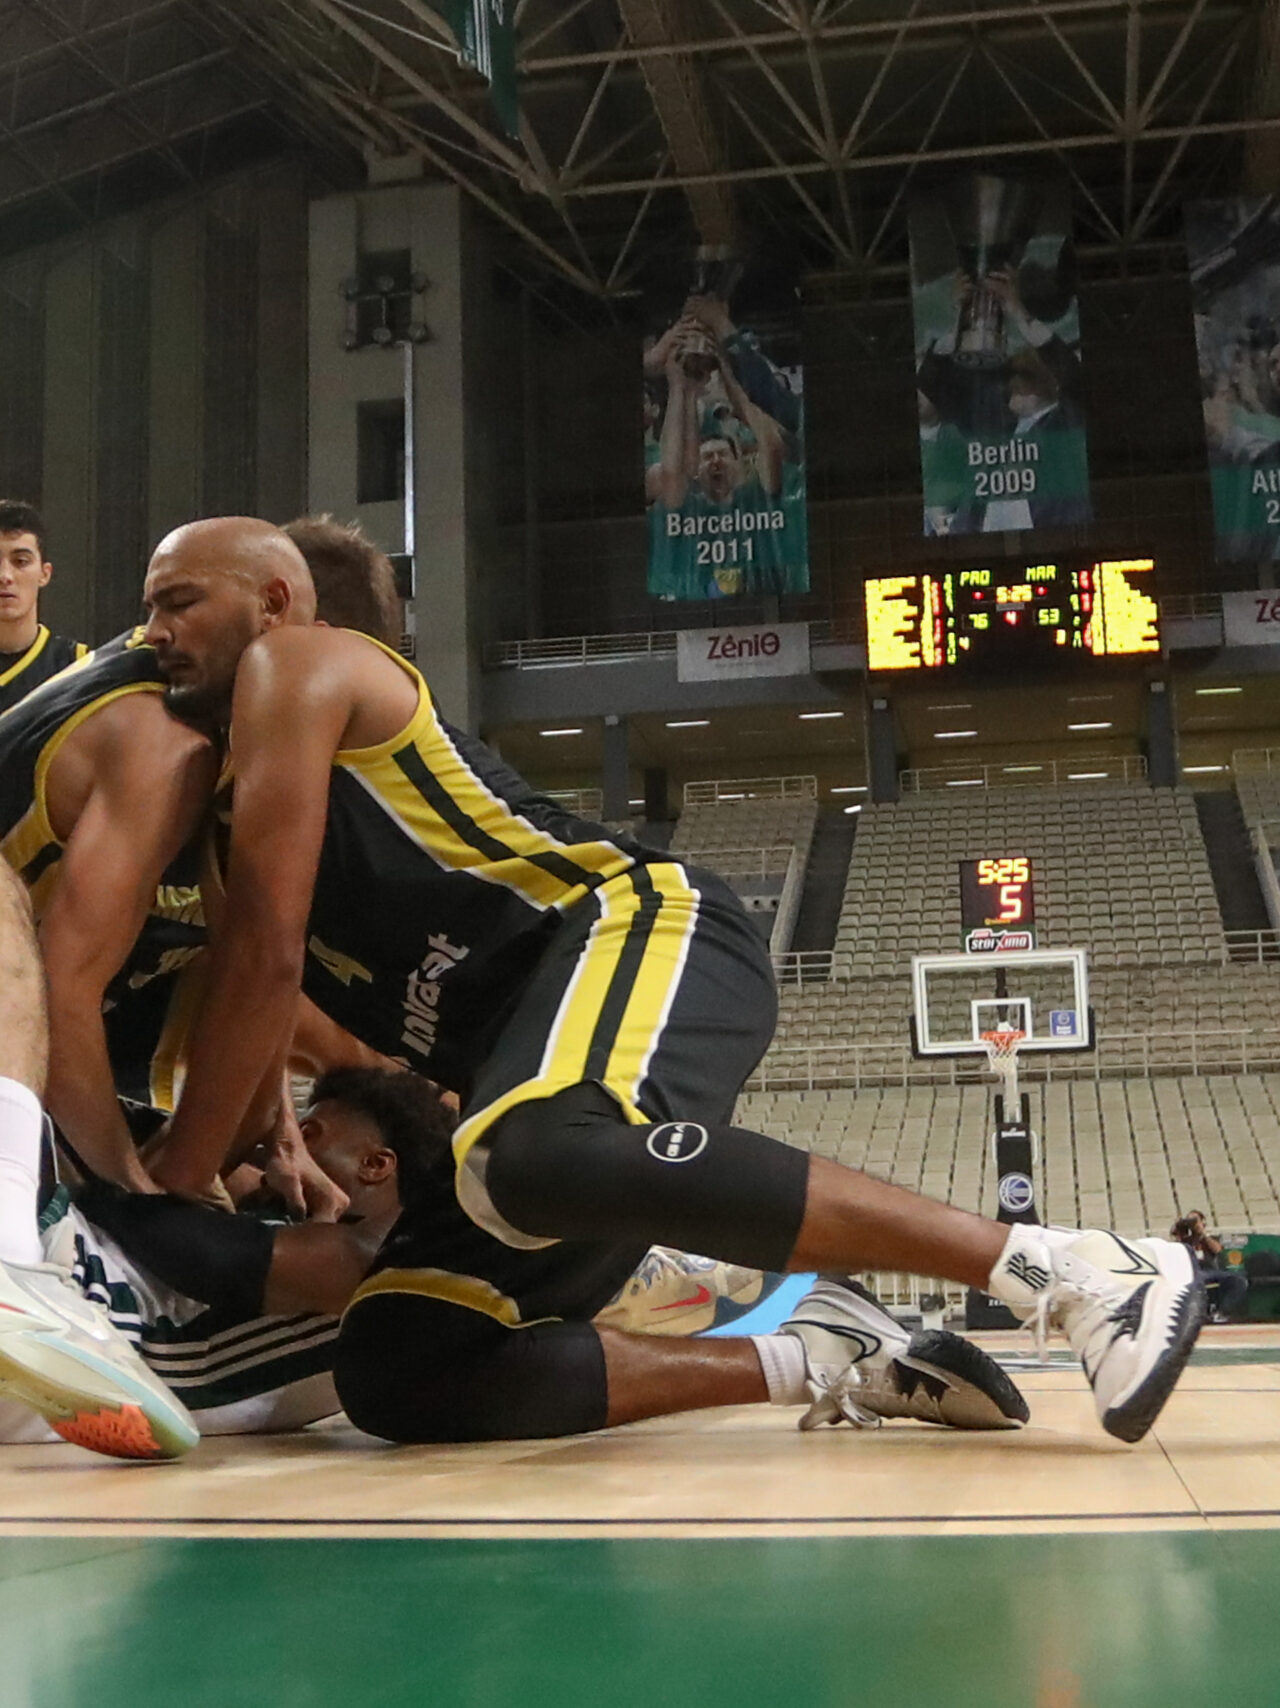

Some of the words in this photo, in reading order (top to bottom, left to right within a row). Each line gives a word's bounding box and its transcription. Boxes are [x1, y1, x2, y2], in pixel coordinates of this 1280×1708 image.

[968, 438, 1039, 466] Berlin
[974, 468, 1036, 497] 2009
[666, 508, 786, 537] Barcelona
[696, 537, 754, 564] 2011
[1025, 564, 1057, 582] MAR
[995, 584, 1033, 604] 5:25
[968, 613, 989, 630] 76
[1038, 608, 1060, 626] 53
[978, 857, 1030, 885] 5:25
[1000, 884, 1023, 919] 5
